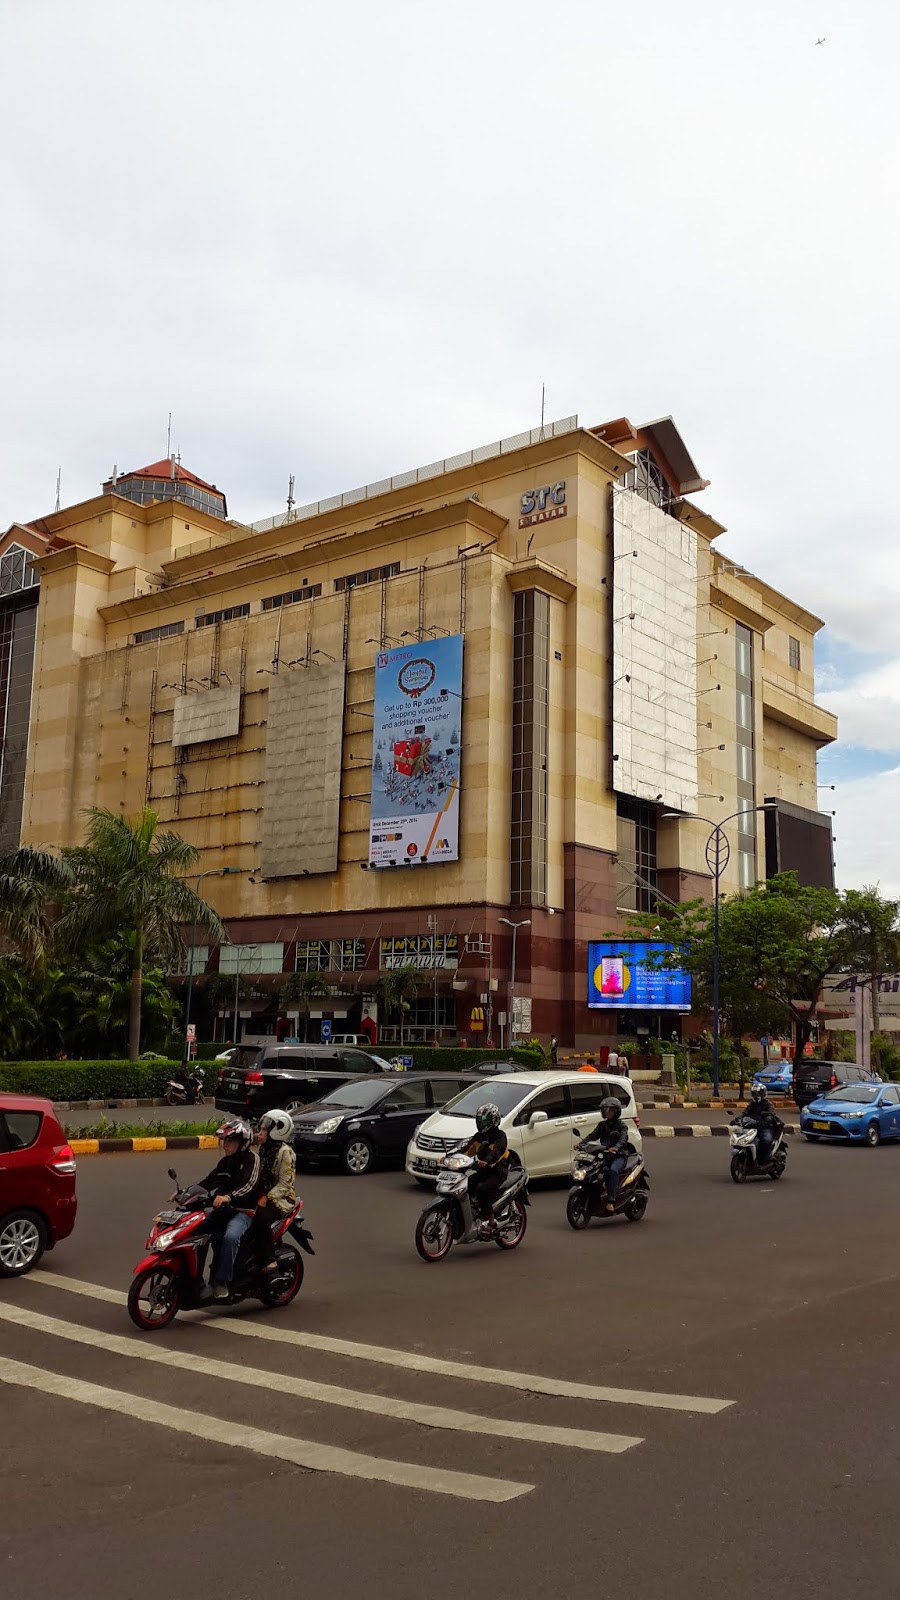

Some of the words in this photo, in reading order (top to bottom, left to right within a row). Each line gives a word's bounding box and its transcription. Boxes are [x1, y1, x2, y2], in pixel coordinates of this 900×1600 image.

[520, 481, 565, 514] STC
[390, 652, 413, 662] METRO
[384, 704, 395, 713] Get
[423, 695, 449, 705] 300,000
[389, 710, 417, 720] shopping
[418, 705, 443, 715] voucher
[382, 721, 393, 730] and
[394, 716, 423, 727] additional
[382, 939, 458, 951] UNITED
